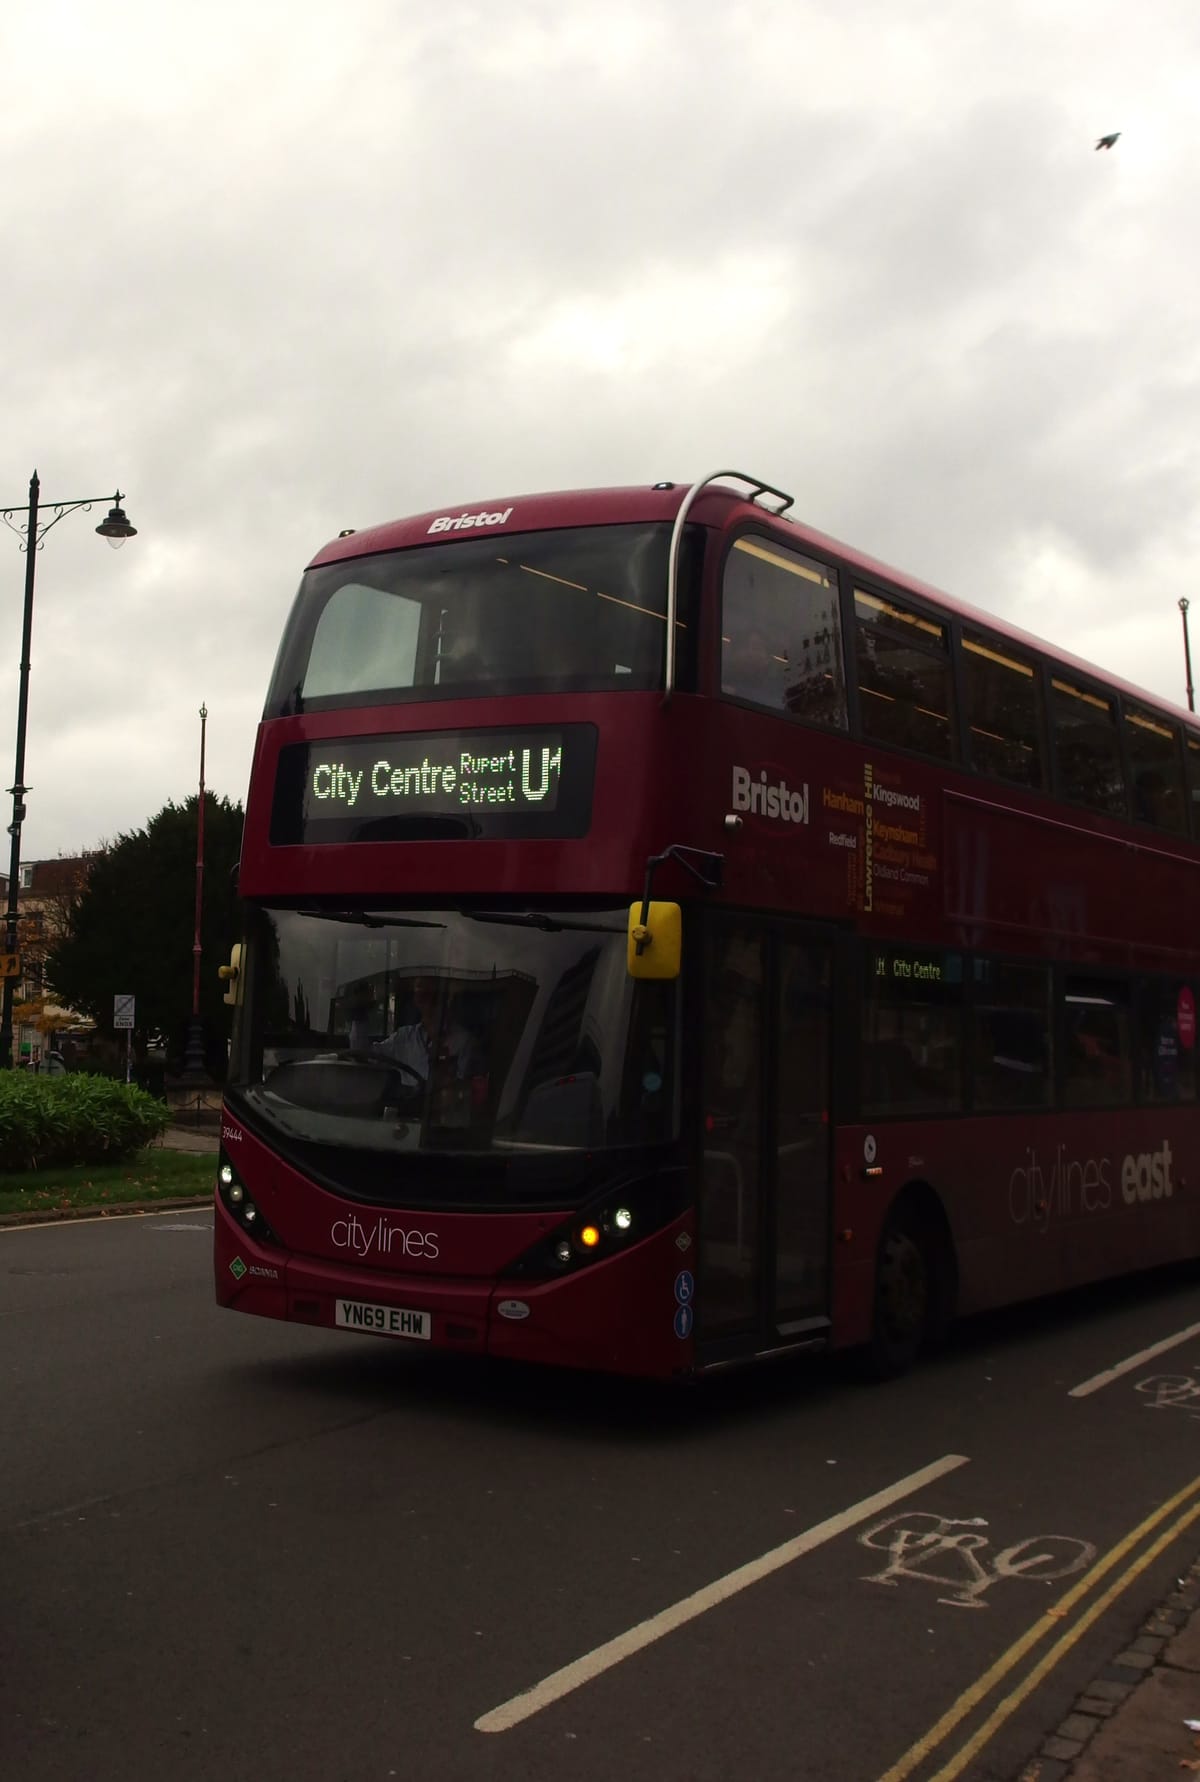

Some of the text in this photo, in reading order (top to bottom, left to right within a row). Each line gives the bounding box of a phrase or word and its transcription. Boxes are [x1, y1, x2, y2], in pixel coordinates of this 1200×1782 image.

[427, 507, 513, 534] Bristol
[460, 750, 516, 774] Rupert
[313, 758, 457, 806] City Centre
[459, 780, 515, 803] Street
[732, 765, 809, 824] Bristol
[823, 787, 865, 815] Hanham
[873, 783, 920, 811] Kingswood
[829, 832, 857, 849] Redfield
[864, 763, 873, 912] Lawrence Hill
[893, 960, 911, 978] City
[913, 961, 941, 980] Centre
[1009, 1139, 1173, 1233] citylines east
[331, 1213, 440, 1259] citylines
[343, 1303, 423, 1335] YN69 EHW
